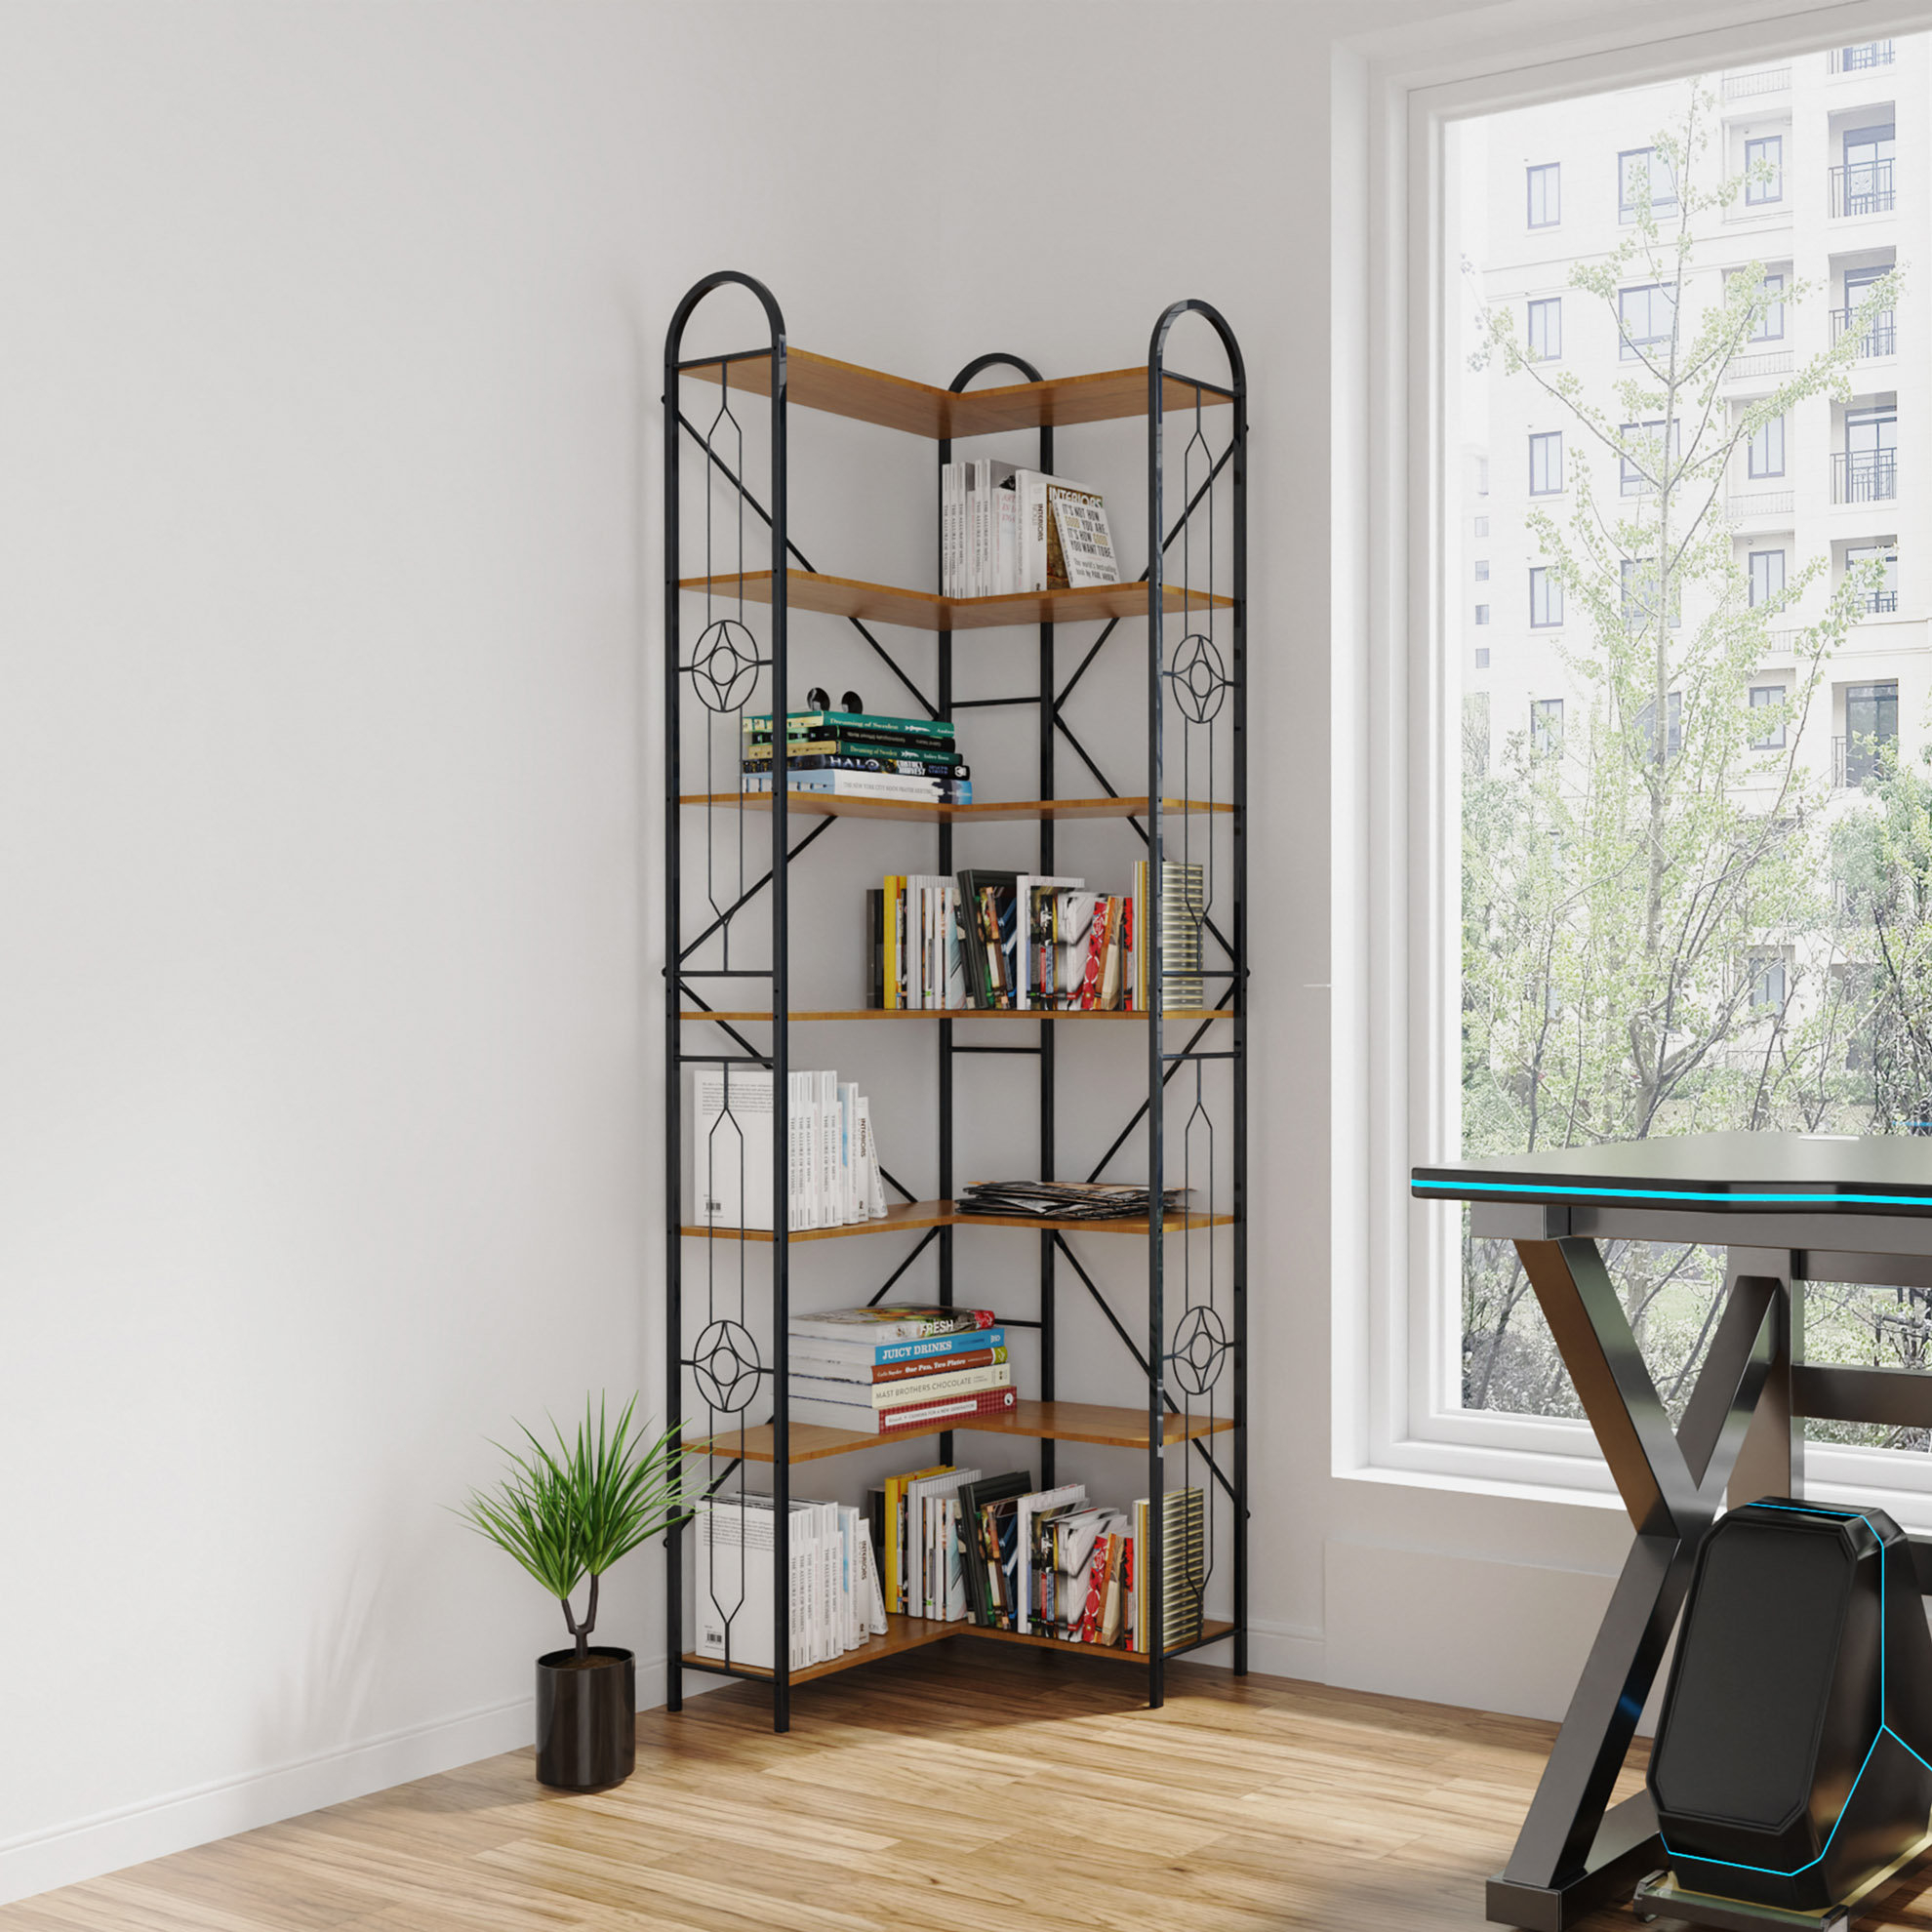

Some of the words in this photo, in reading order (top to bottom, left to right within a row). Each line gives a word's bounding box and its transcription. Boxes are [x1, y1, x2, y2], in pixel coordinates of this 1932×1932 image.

[1049, 487, 1102, 507] INTERIORS
[830, 756, 879, 770] HALO
[920, 1319, 954, 1336] FRESH
[883, 1347, 912, 1360] JUICY
[914, 1341, 952, 1355] DRINKS
[876, 1390, 893, 1398] MAST
[895, 1383, 930, 1396] BROTHERS
[932, 1377, 972, 1390] CHOCOLATE
